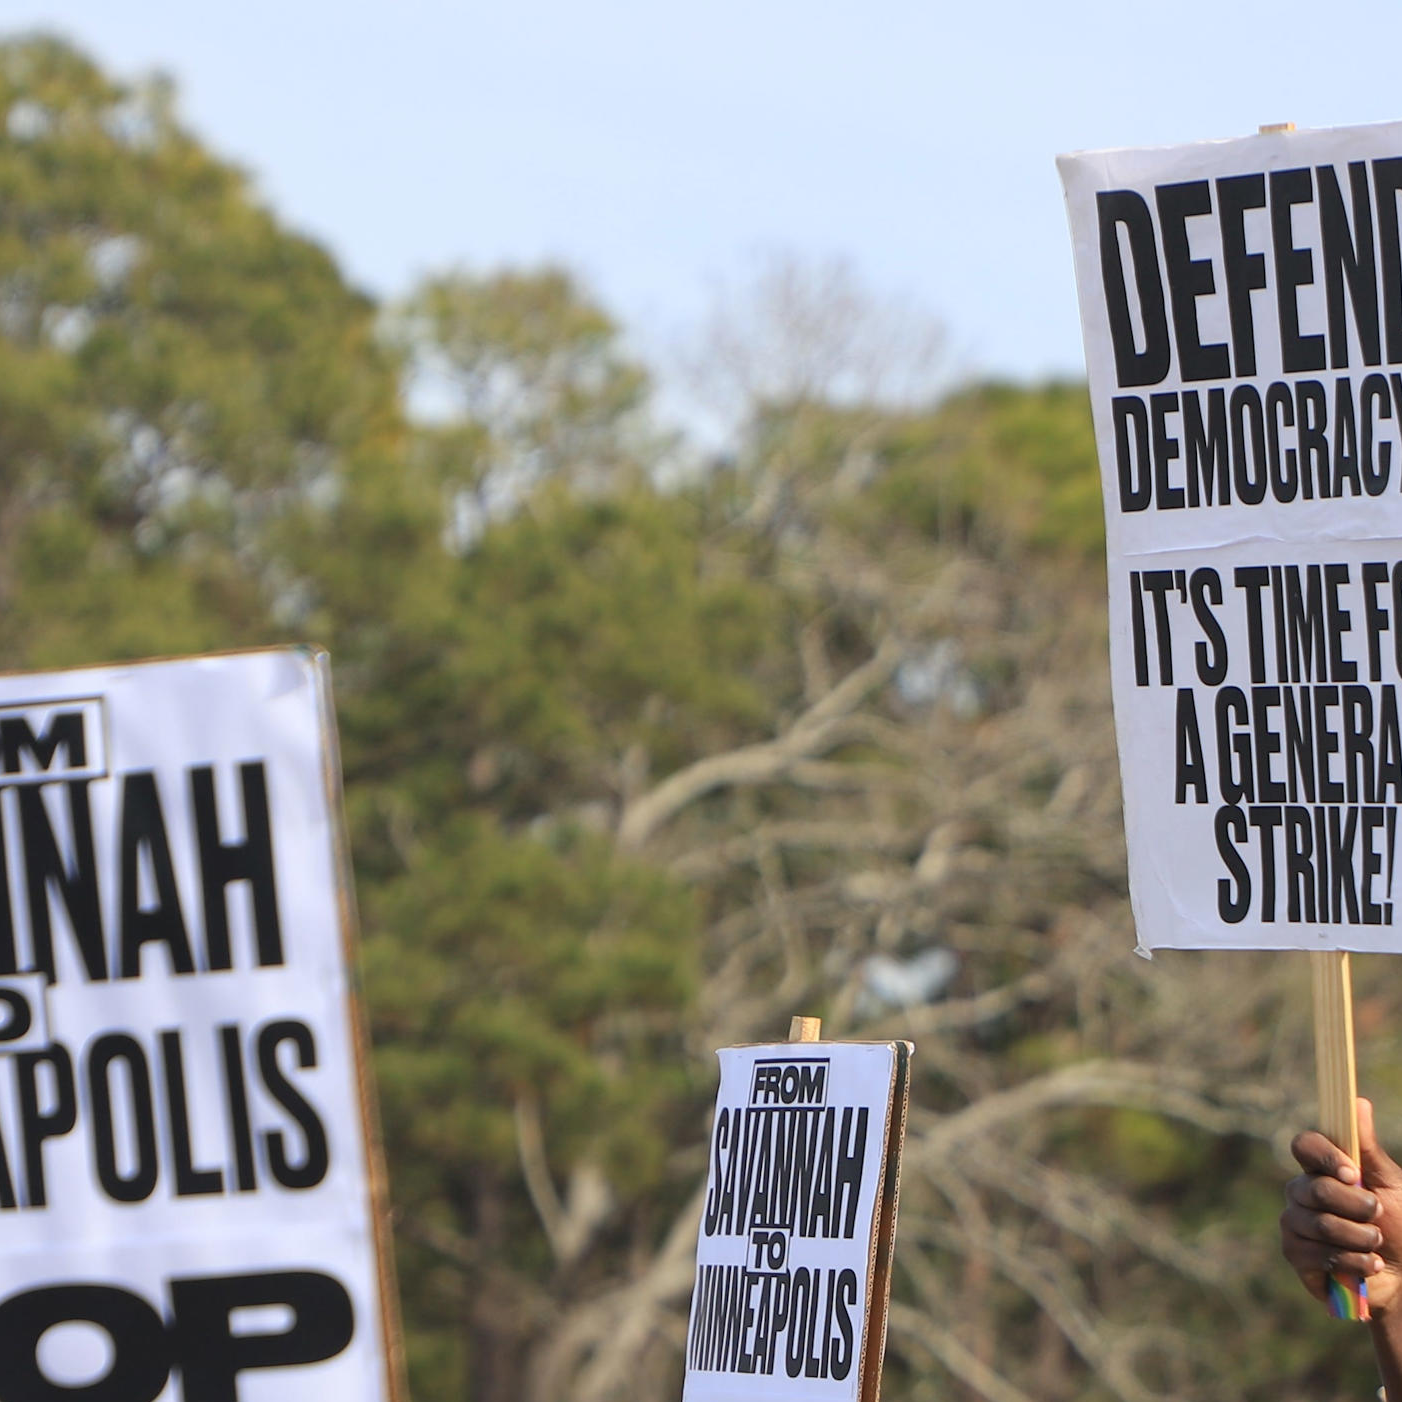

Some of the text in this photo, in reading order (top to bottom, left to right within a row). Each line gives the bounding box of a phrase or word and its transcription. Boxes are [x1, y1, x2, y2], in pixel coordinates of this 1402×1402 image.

[1129, 567, 1228, 686] IT'S
[1234, 563, 1358, 684] TIME
[1175, 687, 1209, 804] A
[1214, 804, 1397, 925] STRIKE!
[752, 1066, 826, 1104] FROM
[704, 1107, 869, 1239] SAVANNAH
[752, 1231, 786, 1270] TO
[689, 1265, 857, 1381] MINNEAPOLIS
